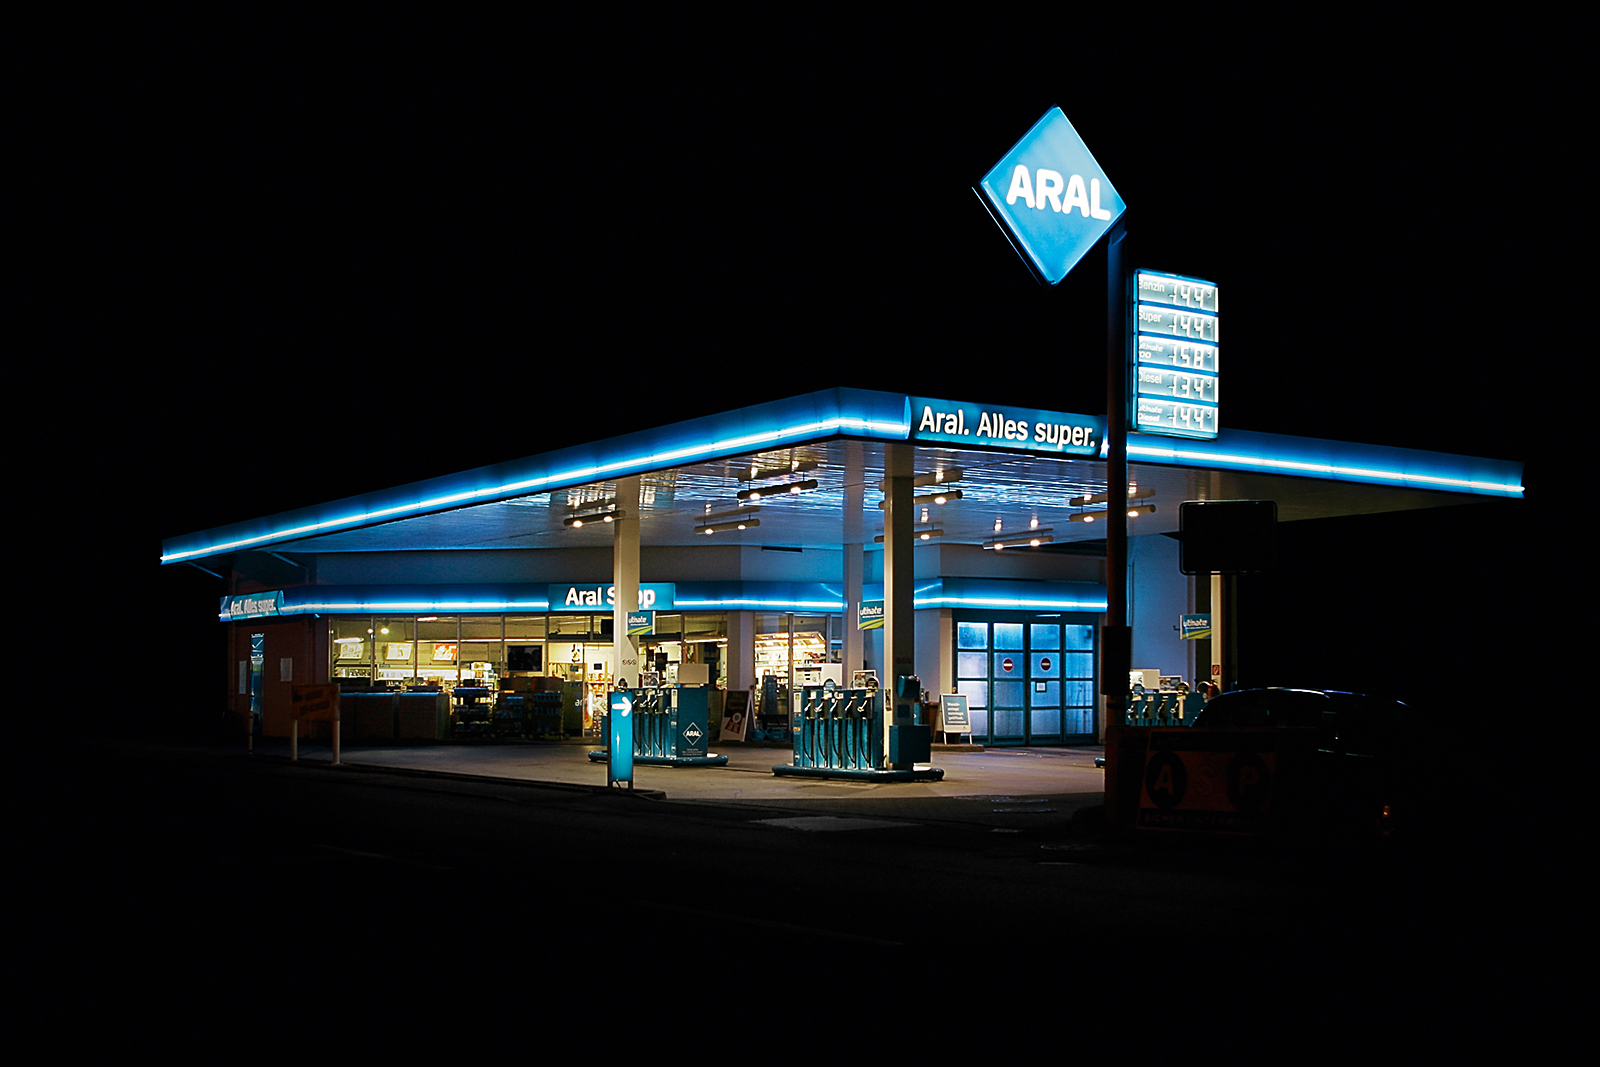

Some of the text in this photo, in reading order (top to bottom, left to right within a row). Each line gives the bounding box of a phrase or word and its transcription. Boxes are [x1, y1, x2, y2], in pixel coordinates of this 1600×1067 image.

[1006, 164, 1111, 221] ARAL
[918, 405, 1096, 450] Aral. Alles super.
[565, 586, 656, 609] Aral Sp
